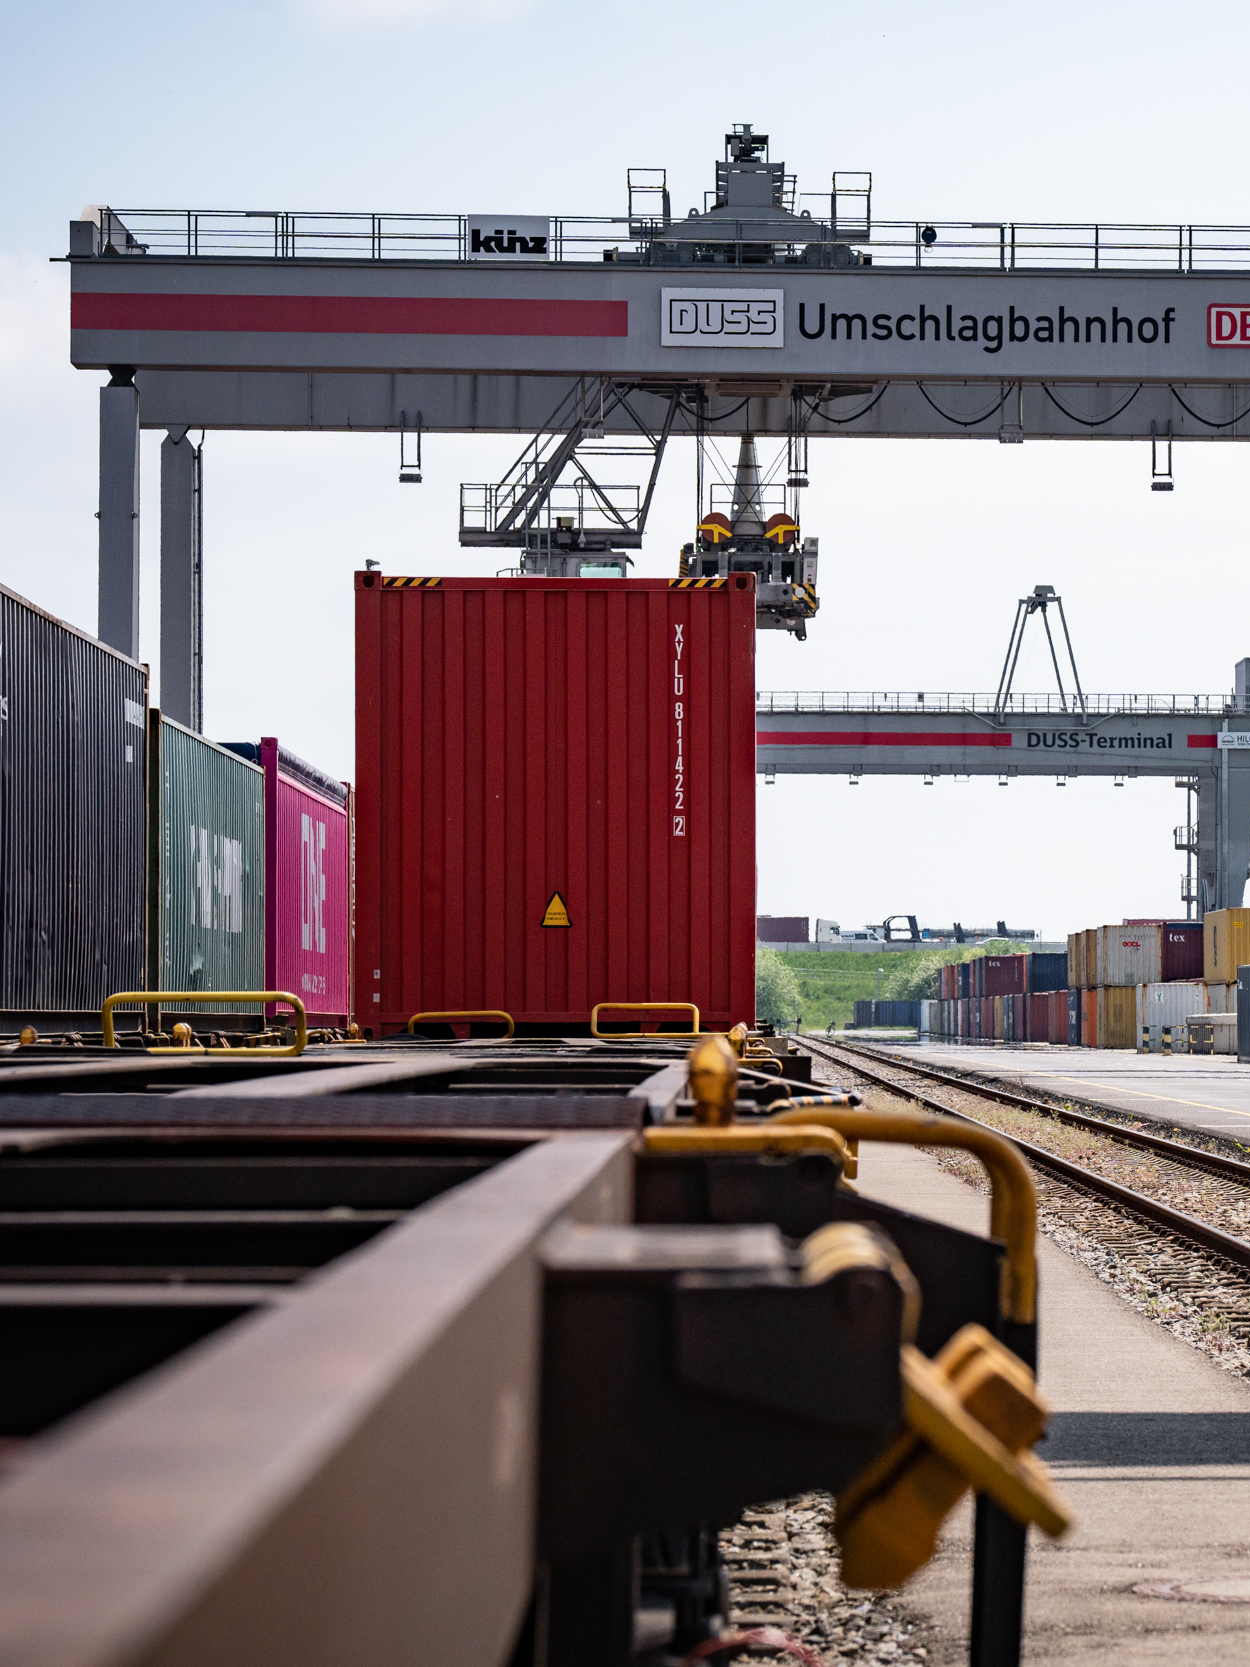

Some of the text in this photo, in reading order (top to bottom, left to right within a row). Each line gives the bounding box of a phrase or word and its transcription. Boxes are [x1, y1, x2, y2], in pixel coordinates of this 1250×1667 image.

[471, 228, 547, 254] künz
[668, 299, 778, 336] DUSS
[799, 303, 1176, 353] Umschlagbahnhof
[674, 624, 684, 696] XYLU
[674, 702, 684, 810] 811422
[1027, 732, 1173, 749] DUSS-Terminal
[1168, 932, 1186, 942] tex
